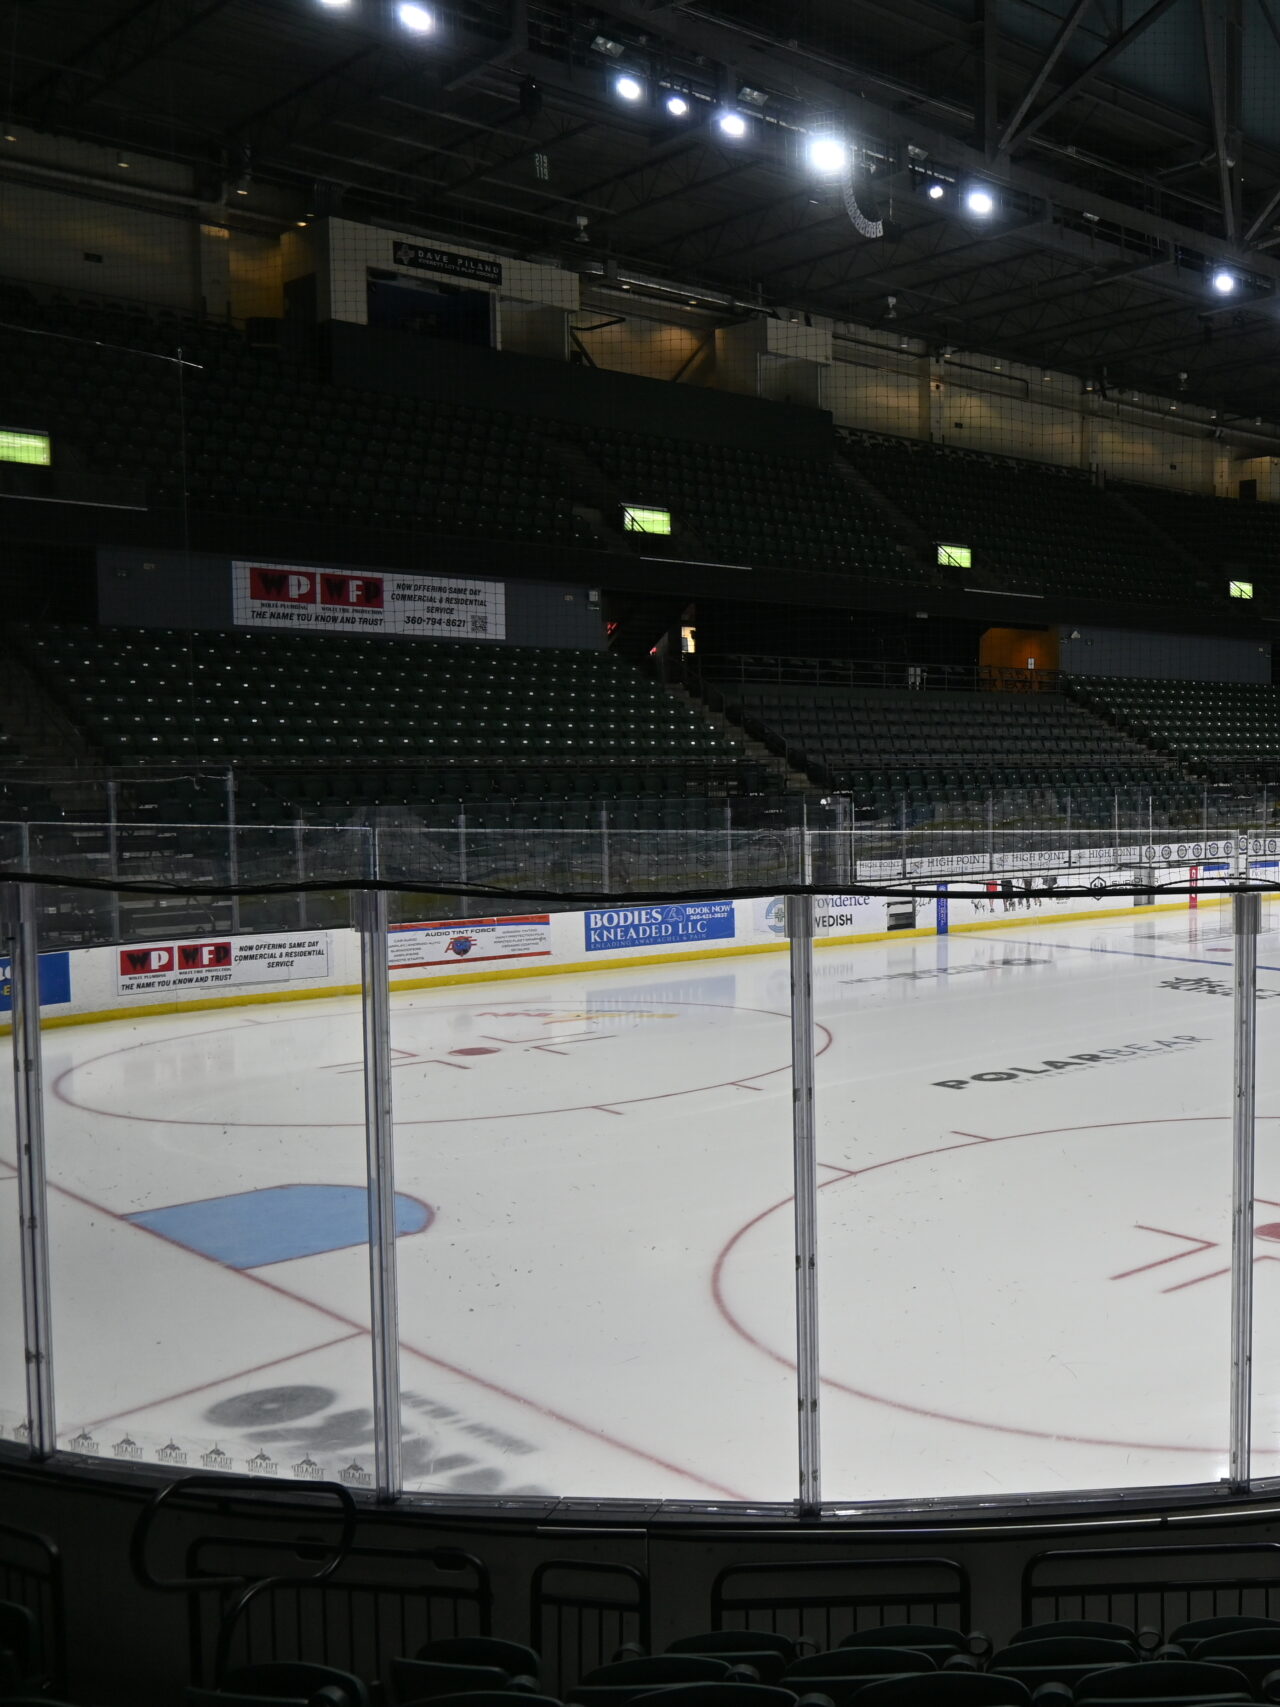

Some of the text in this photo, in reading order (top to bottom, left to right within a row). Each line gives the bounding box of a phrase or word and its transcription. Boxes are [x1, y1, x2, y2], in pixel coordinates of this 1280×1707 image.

[418, 250, 499, 274] DAVE PILAND
[260, 574, 310, 599] WP
[324, 578, 380, 604] WFP
[396, 583, 482, 596] NOW OFFERING SAME DAY
[391, 593, 437, 604] COMMERCIAL
[445, 597, 487, 607] RESIDENTIAL
[426, 606, 454, 615] SERVICE
[251, 611, 383, 627] THE NAME YOU KNOW AND TRUST
[927, 854, 987, 868] HIGH POINT
[1012, 851, 1067, 863] HIGH POINT
[815, 895, 871, 909] rovidence
[686, 904, 732, 915] BOOK NOW
[590, 909, 663, 928] BODIES
[815, 914, 853, 929] WEDISH
[425, 927, 497, 938] AUDIO TINT FORCE
[590, 920, 708, 943] KNEADED LLC
[239, 940, 320, 952] NOW OFFERING SAME DAY
[590, 939, 632, 949] KNEADING
[126, 950, 169, 971] WP
[234, 952, 278, 963] COMMERCIAL
[285, 949, 325, 958] RESIDENTIAL
[267, 960, 294, 969] SERVICE
[121, 974, 233, 992] THE NAME YOU KNOW AND TRUST
[930, 1034, 1213, 1090] POLARBEAR
